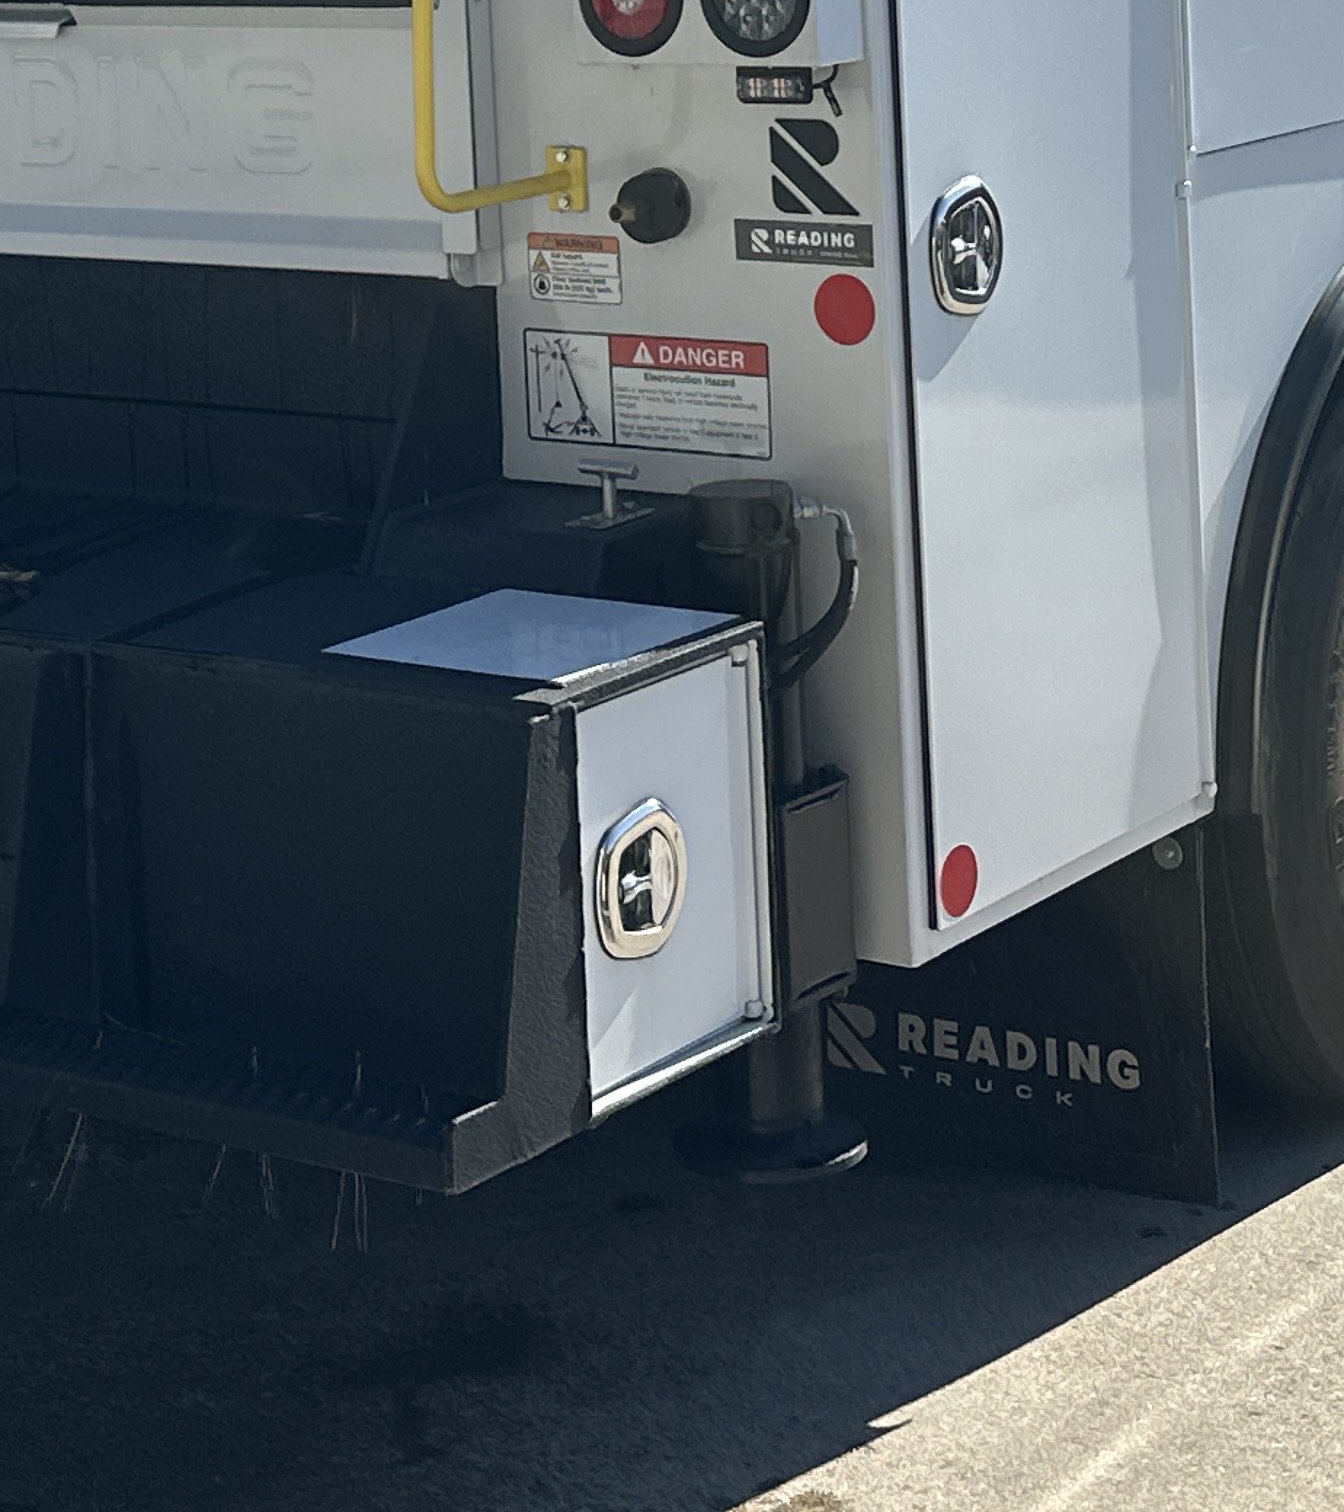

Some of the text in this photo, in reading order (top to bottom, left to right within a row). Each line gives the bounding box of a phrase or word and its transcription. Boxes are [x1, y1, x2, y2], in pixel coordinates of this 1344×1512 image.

[774, 229, 855, 248] READING
[658, 345, 745, 369] DANGER
[897, 1010, 1142, 1091] READING
[898, 1064, 1074, 1109] TRUCK
